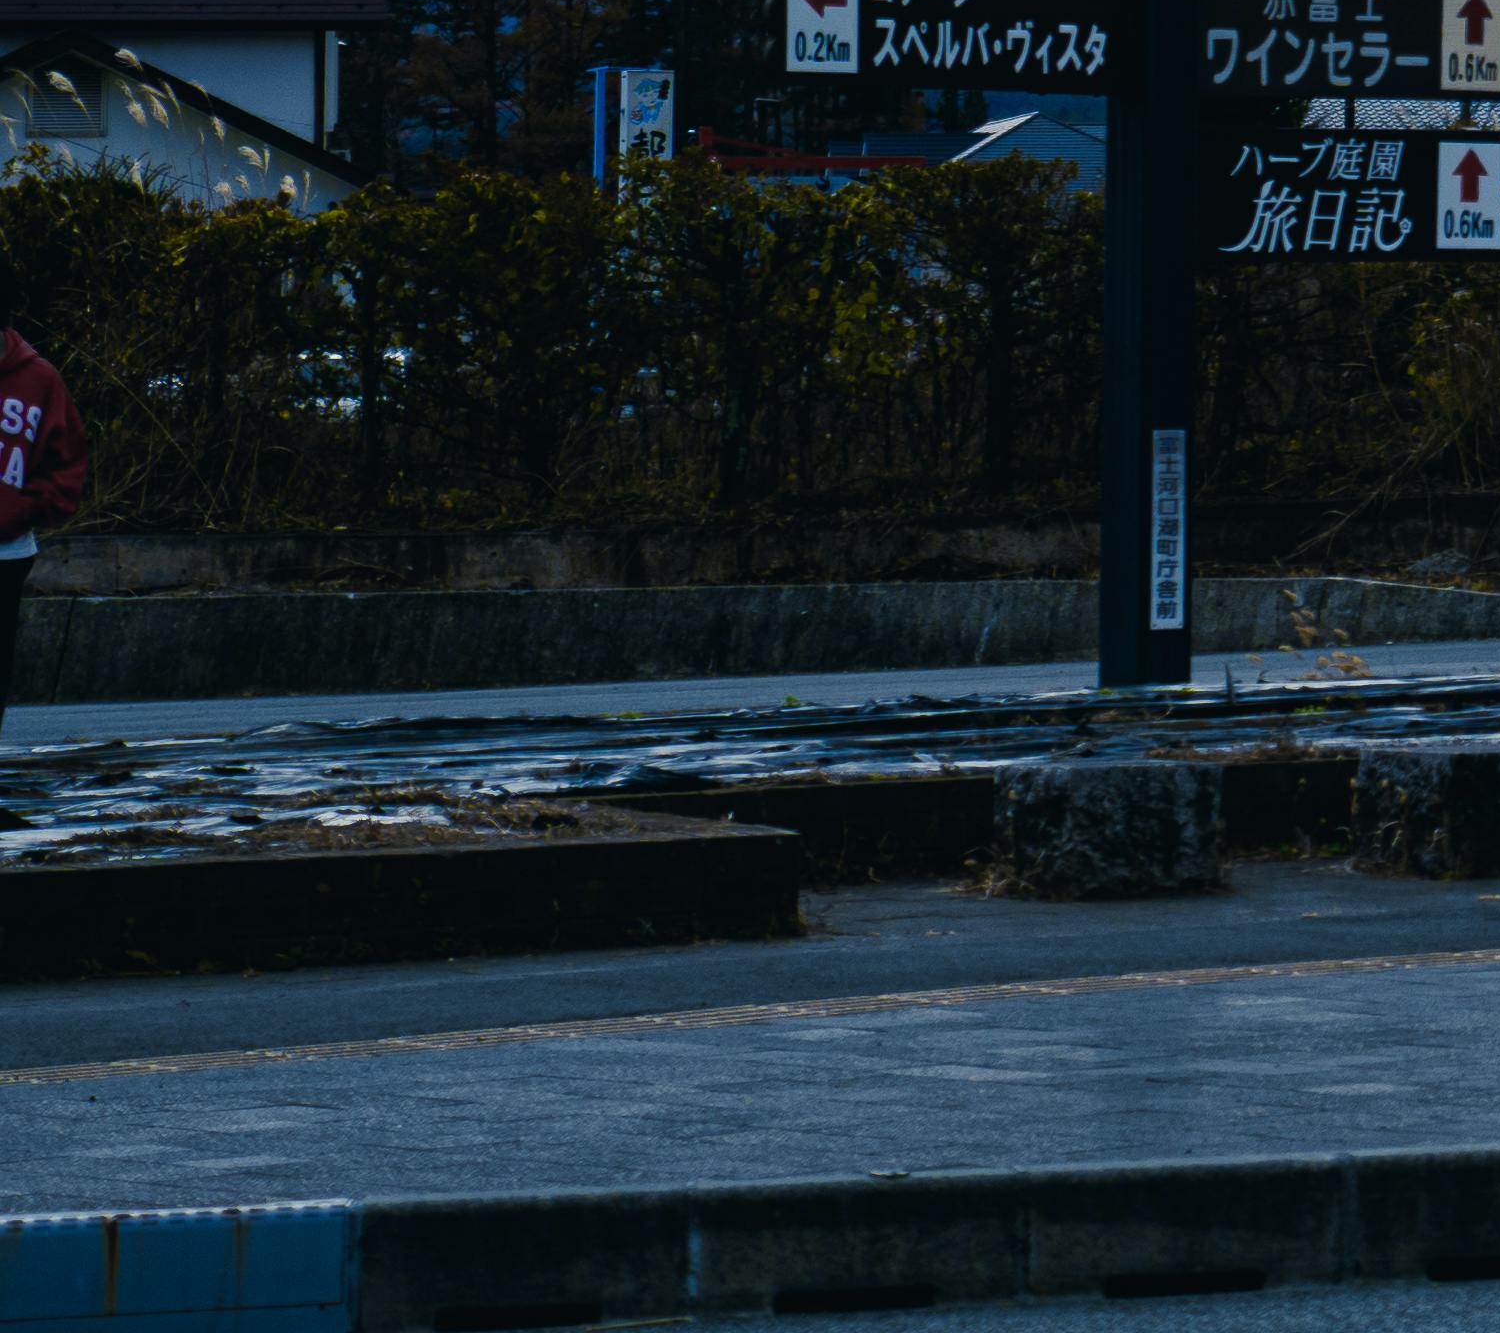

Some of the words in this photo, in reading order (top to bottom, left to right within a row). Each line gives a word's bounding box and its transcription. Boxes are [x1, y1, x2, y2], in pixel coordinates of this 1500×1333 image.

[795, 31, 850, 63] 0.2Km
[1206, 28, 1429, 87] ワインセラー
[1448, 53, 1498, 83] 0.6Km
[1230, 137, 1404, 181] ハーブ庭園
[1218, 181, 1412, 253] 旅日記
[1443, 209, 1494, 239] 0.6Km
